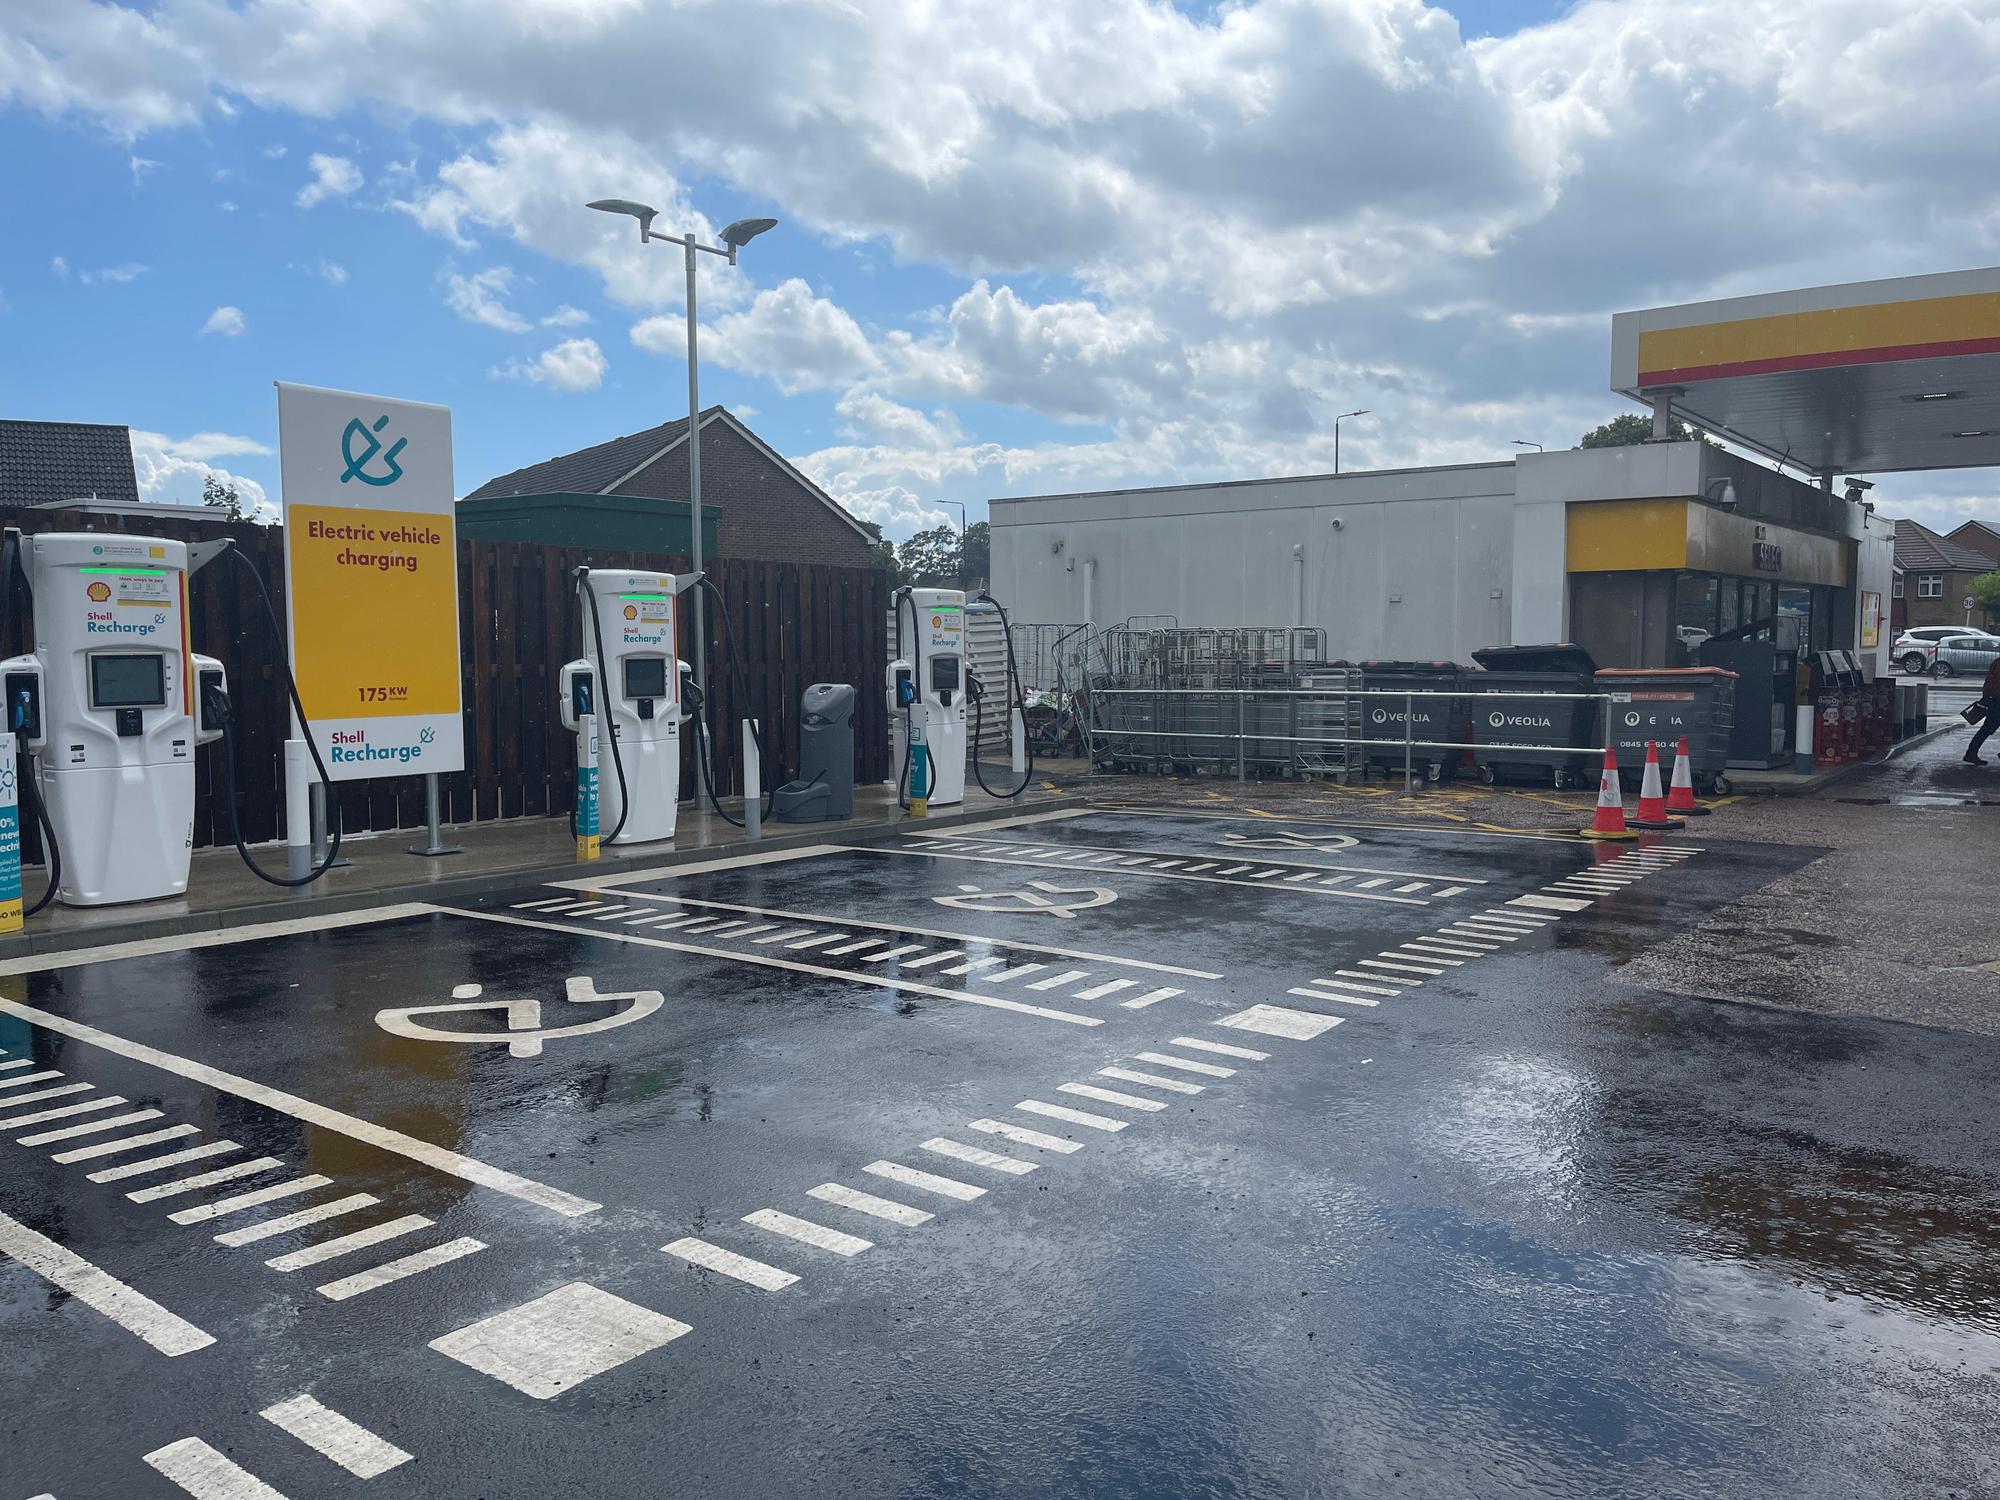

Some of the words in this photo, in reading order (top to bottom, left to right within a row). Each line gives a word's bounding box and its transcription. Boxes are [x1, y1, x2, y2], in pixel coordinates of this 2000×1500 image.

[308, 520, 375, 541] Electric
[379, 526, 441, 545] vehicle
[336, 547, 418, 572] charging
[87, 612, 112, 621] Shell
[88, 621, 155, 635] Recharge
[623, 634, 662, 645] Recharge
[358, 687, 388, 702] 175
[389, 686, 408, 696] KW
[1506, 716, 1551, 727] VEOLIA
[331, 730, 365, 745] Shell
[1620, 741, 1641, 749] 0845
[331, 743, 422, 763] Recharge
